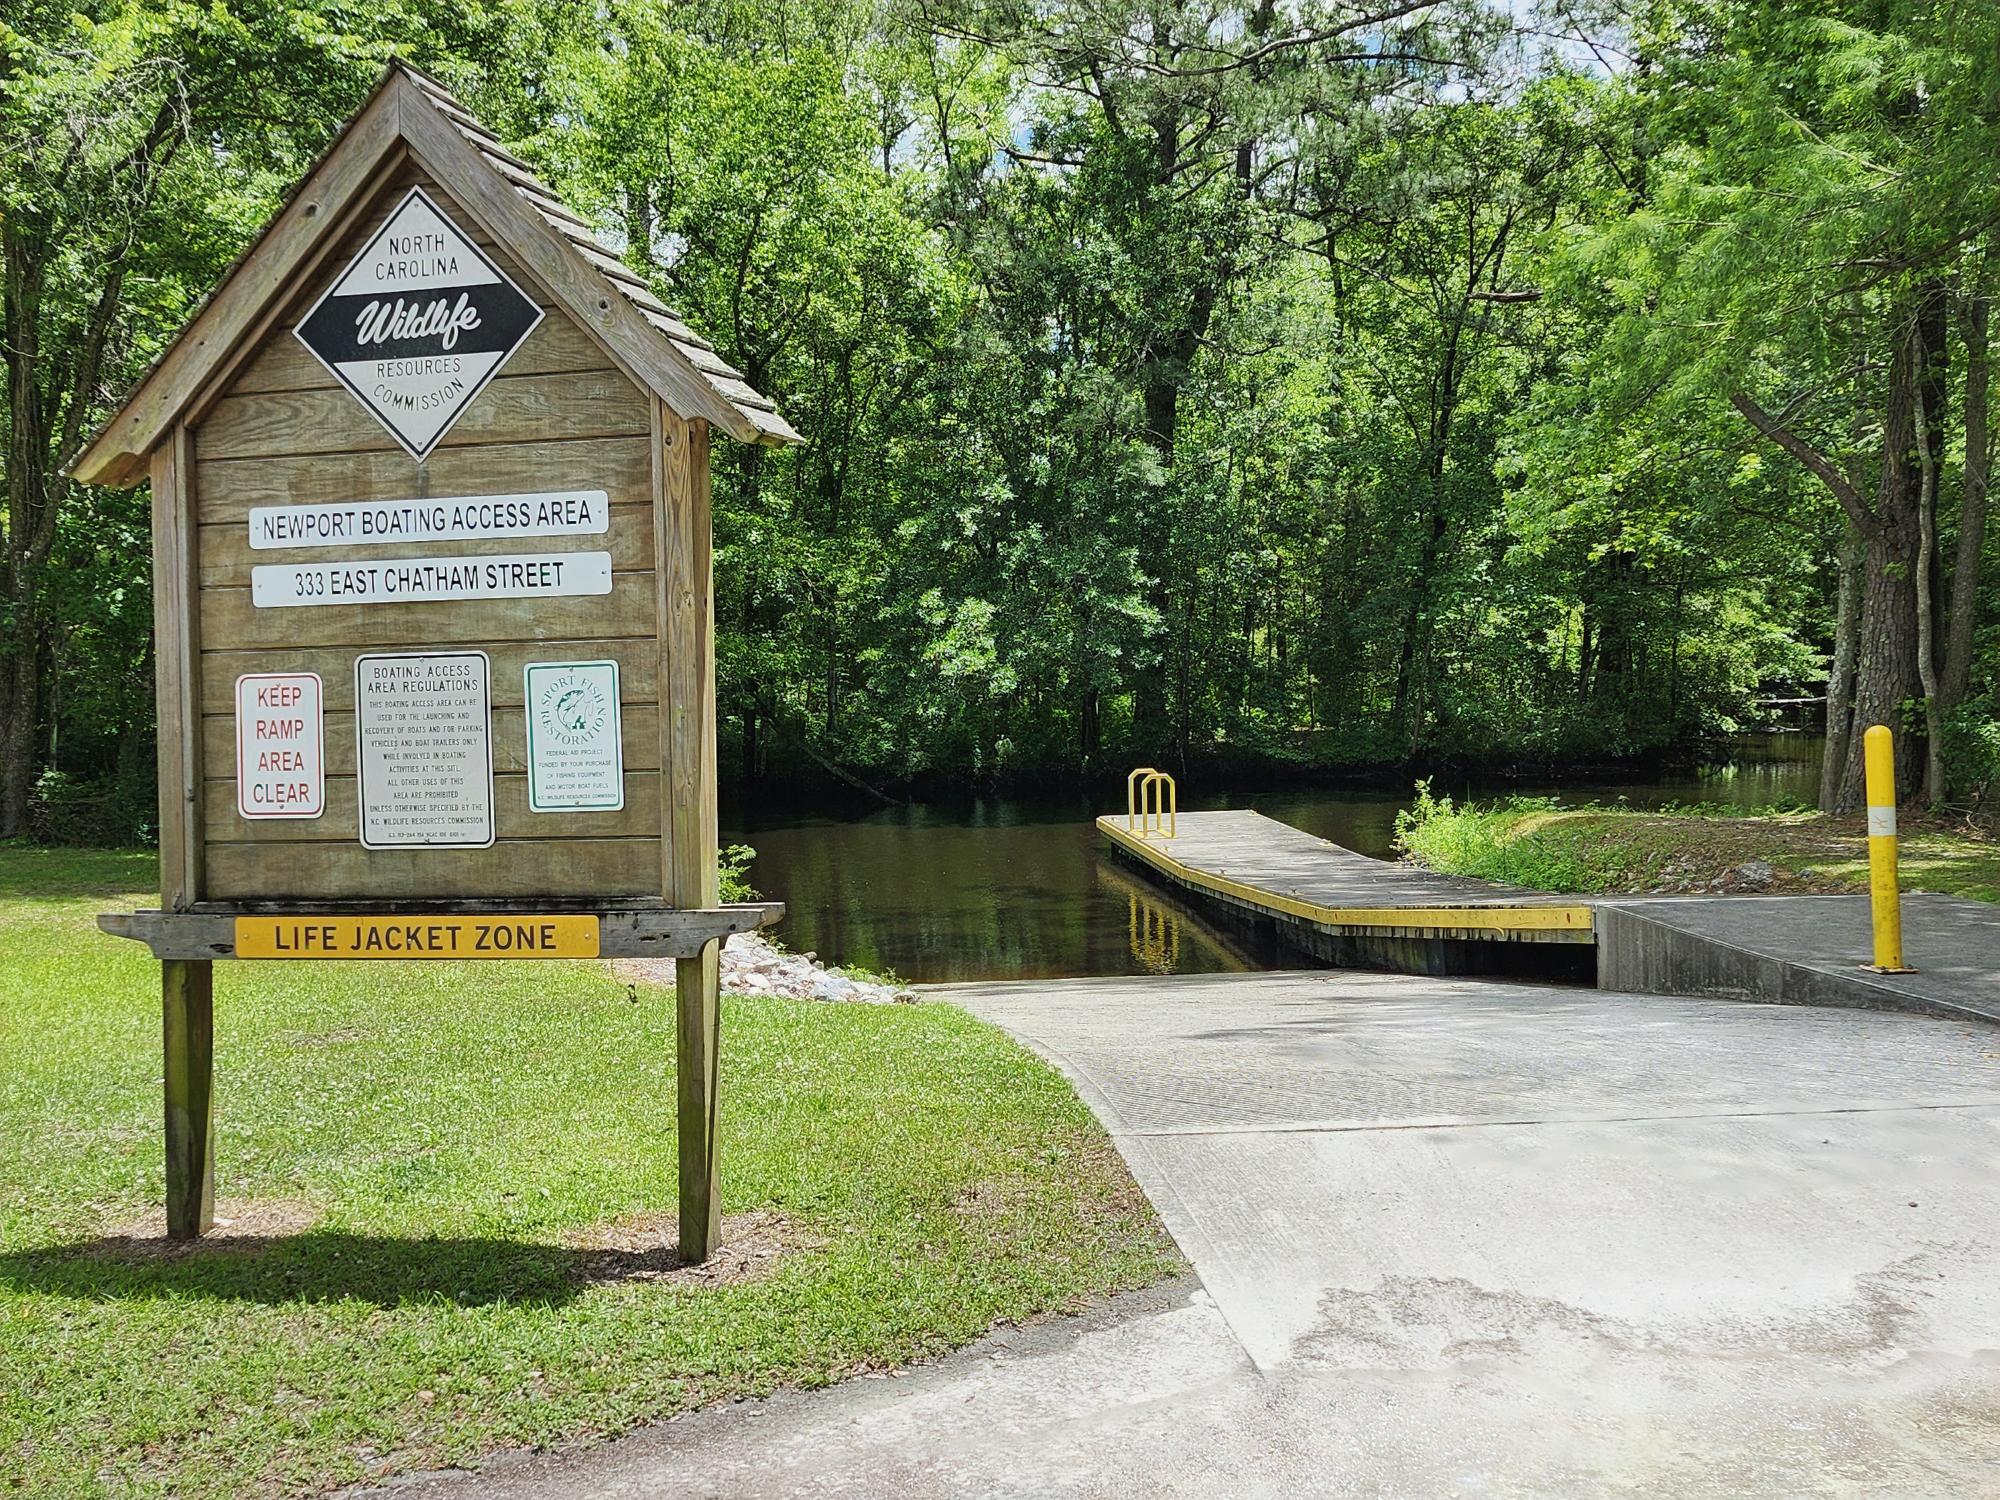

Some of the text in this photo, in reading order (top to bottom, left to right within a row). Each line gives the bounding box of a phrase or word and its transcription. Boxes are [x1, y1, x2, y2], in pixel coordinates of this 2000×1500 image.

[389, 234, 445, 255] NORTH
[376, 257, 459, 280] CAROLINA
[355, 291, 482, 350] Wildlife
[377, 357, 461, 378] RESOURCES
[373, 378, 465, 411] COMMISSION
[262, 499, 592, 540] NEWPORT BOATING ACCESS AREA
[295, 562, 564, 596] 333 EAST CHATHAM STREET
[374, 665, 470, 678] BOATING ACCESS
[258, 687, 301, 707] KEEP
[368, 680, 478, 693] AREA REGULATIONS
[542, 675, 605, 706] SPORT FISH
[385, 700, 409, 708] BOATING
[256, 720, 303, 740] RAMP
[408, 726, 426, 734] BOATS
[541, 707, 607, 745] RESTORATION
[258, 752, 304, 771] AREA
[253, 783, 310, 804] CLEAR
[275, 925, 557, 951] LIFE JACKET ZONE
